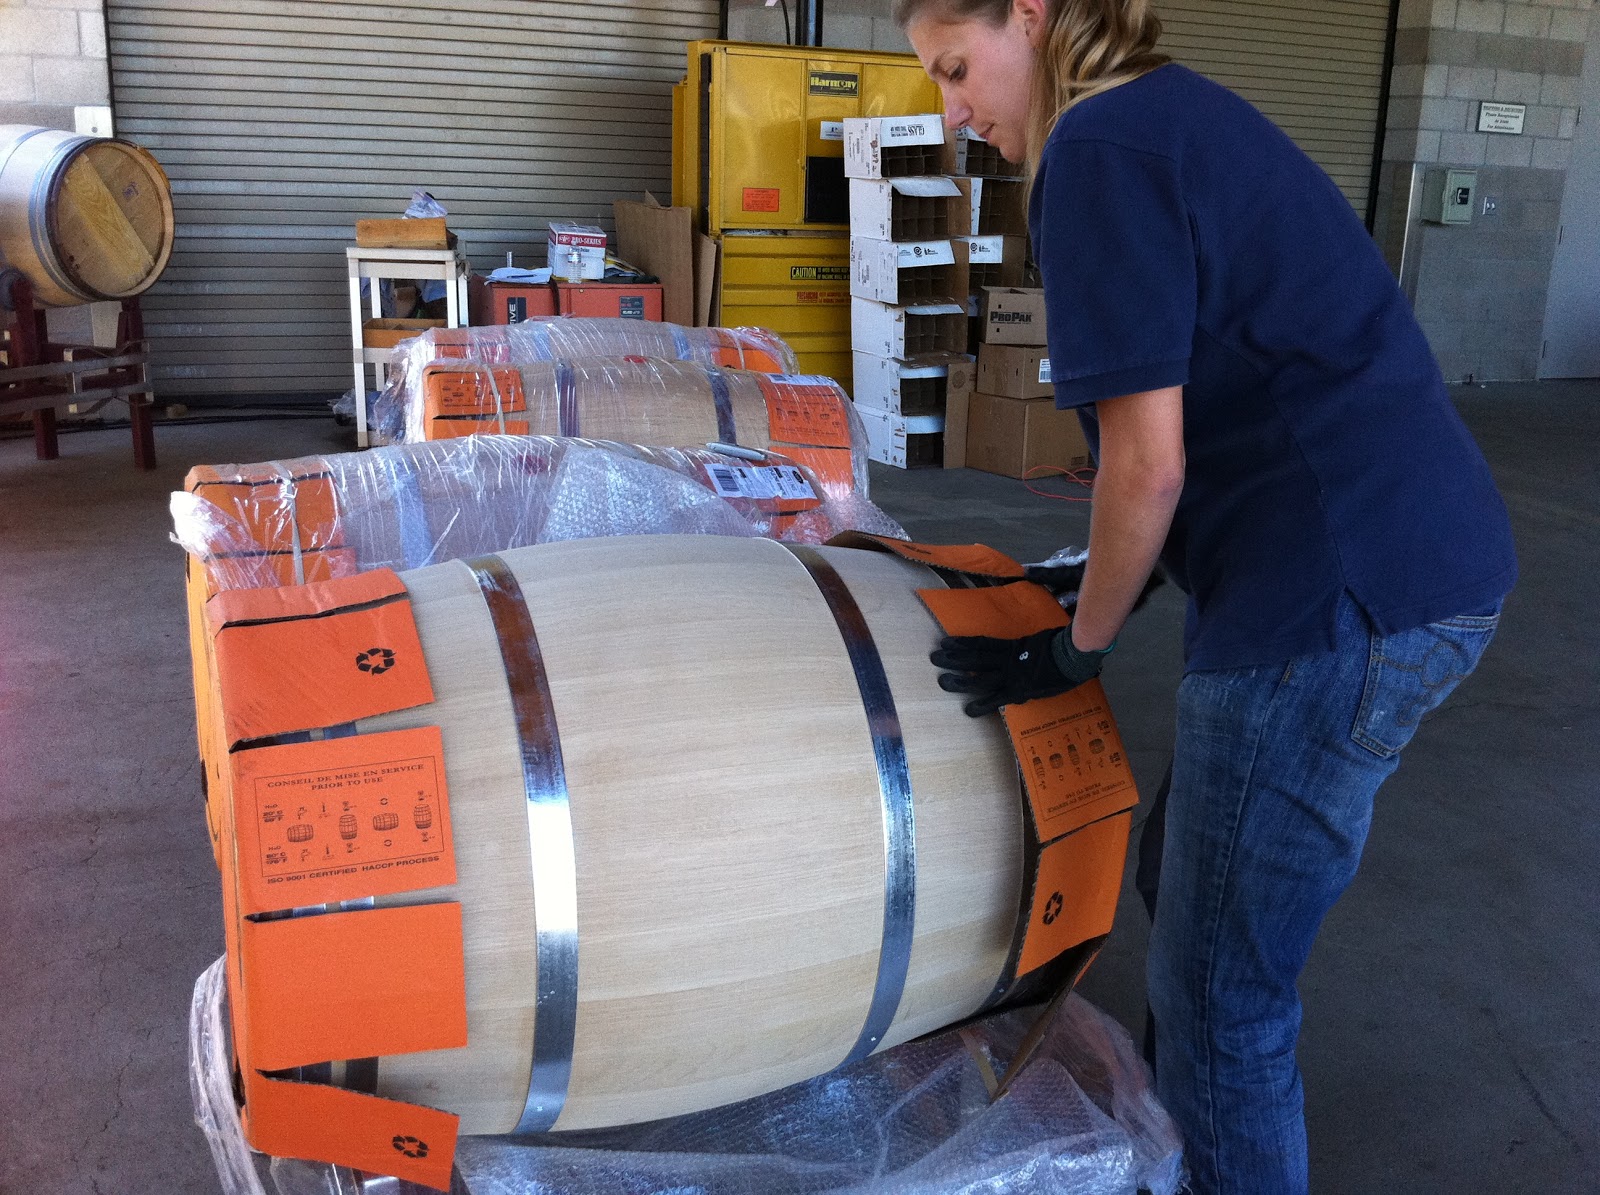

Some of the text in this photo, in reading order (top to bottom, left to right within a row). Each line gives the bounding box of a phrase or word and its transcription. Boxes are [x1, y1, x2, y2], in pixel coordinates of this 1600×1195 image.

[792, 267, 816, 278] CAUTION
[267, 778, 314, 788] CONSEIL
[335, 772, 360, 780] MISE
[381, 764, 424, 775] SERVICE
[311, 782, 343, 790] PRIOR
[309, 867, 357, 878] CERTIFIED
[362, 862, 394, 871] HACCP
[396, 855, 440, 867] PROCESS
